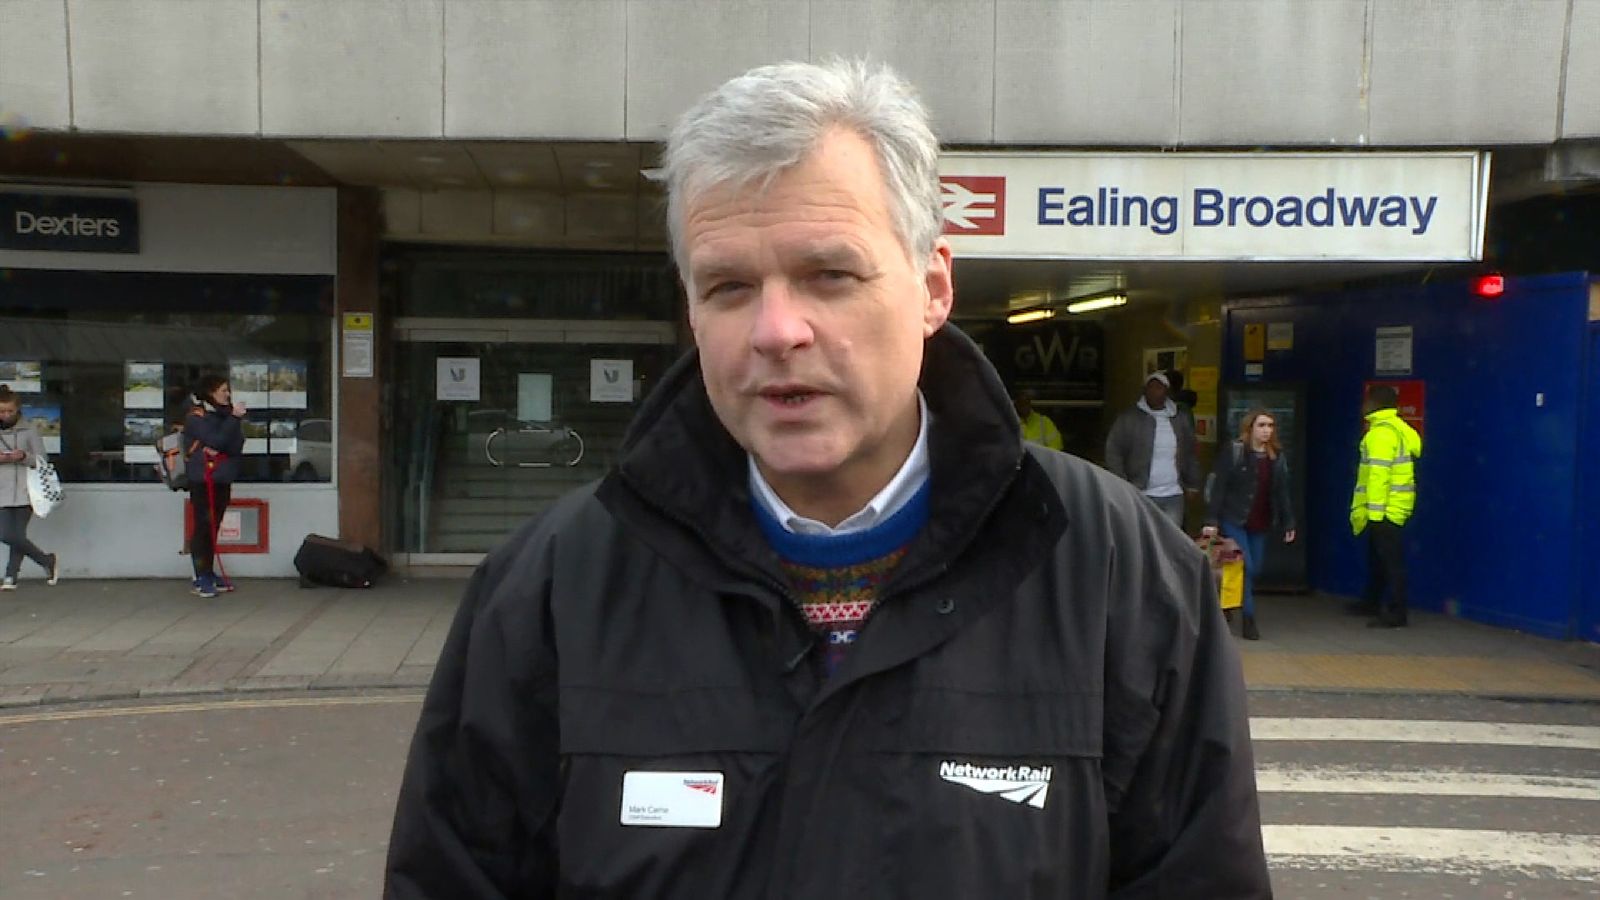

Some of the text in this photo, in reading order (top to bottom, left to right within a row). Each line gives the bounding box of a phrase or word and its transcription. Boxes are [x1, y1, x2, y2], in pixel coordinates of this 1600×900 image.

[15, 210, 120, 237] Dexters
[1037, 187, 1438, 236] Ealing Broadway
[1015, 331, 1098, 372] GWR
